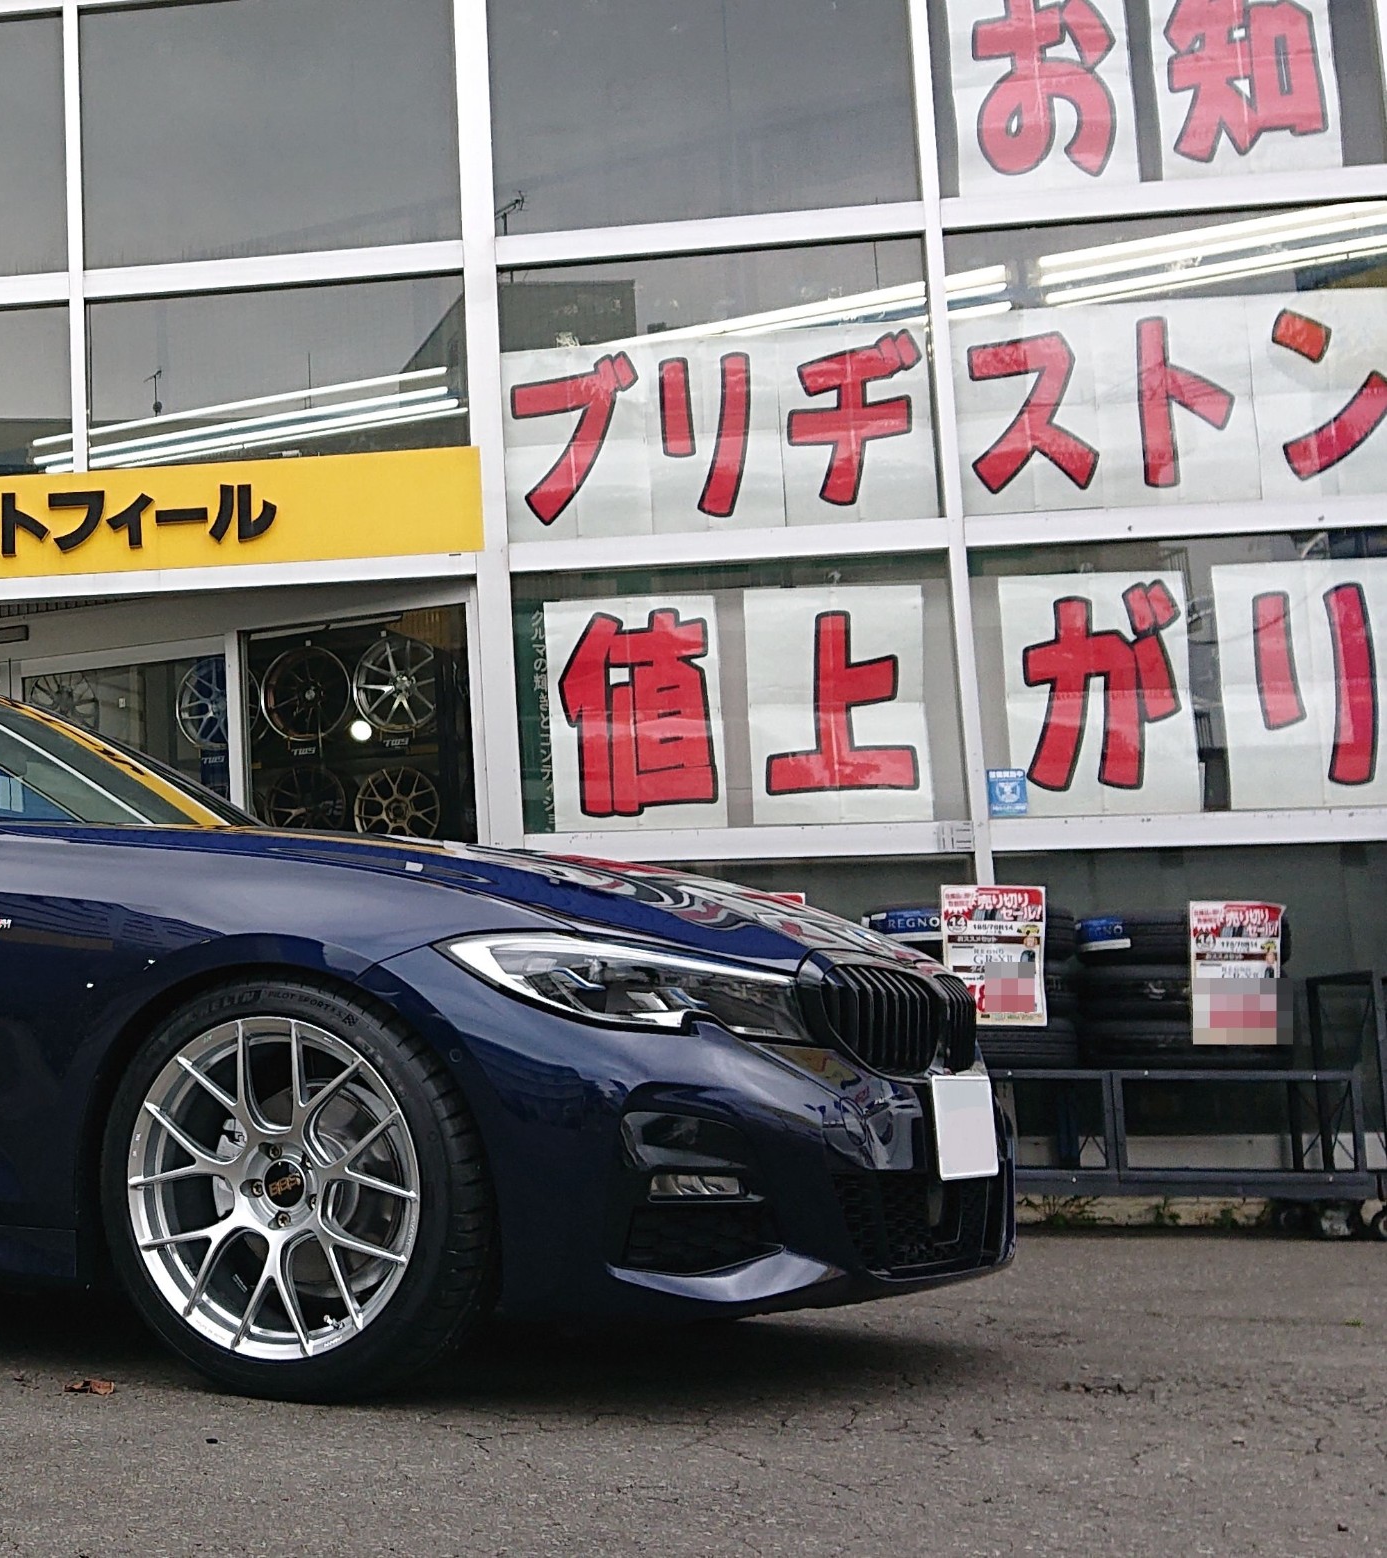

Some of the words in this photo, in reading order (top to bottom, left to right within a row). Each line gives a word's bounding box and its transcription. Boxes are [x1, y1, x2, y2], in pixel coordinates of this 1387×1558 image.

[511, 309, 1387, 525] ブリヂストン
[559, 580, 1379, 818] 値上がり
[977, 892, 1029, 910] 売り切り
[888, 916, 941, 930] REGNO
[269, 1174, 301, 1197] BBS
